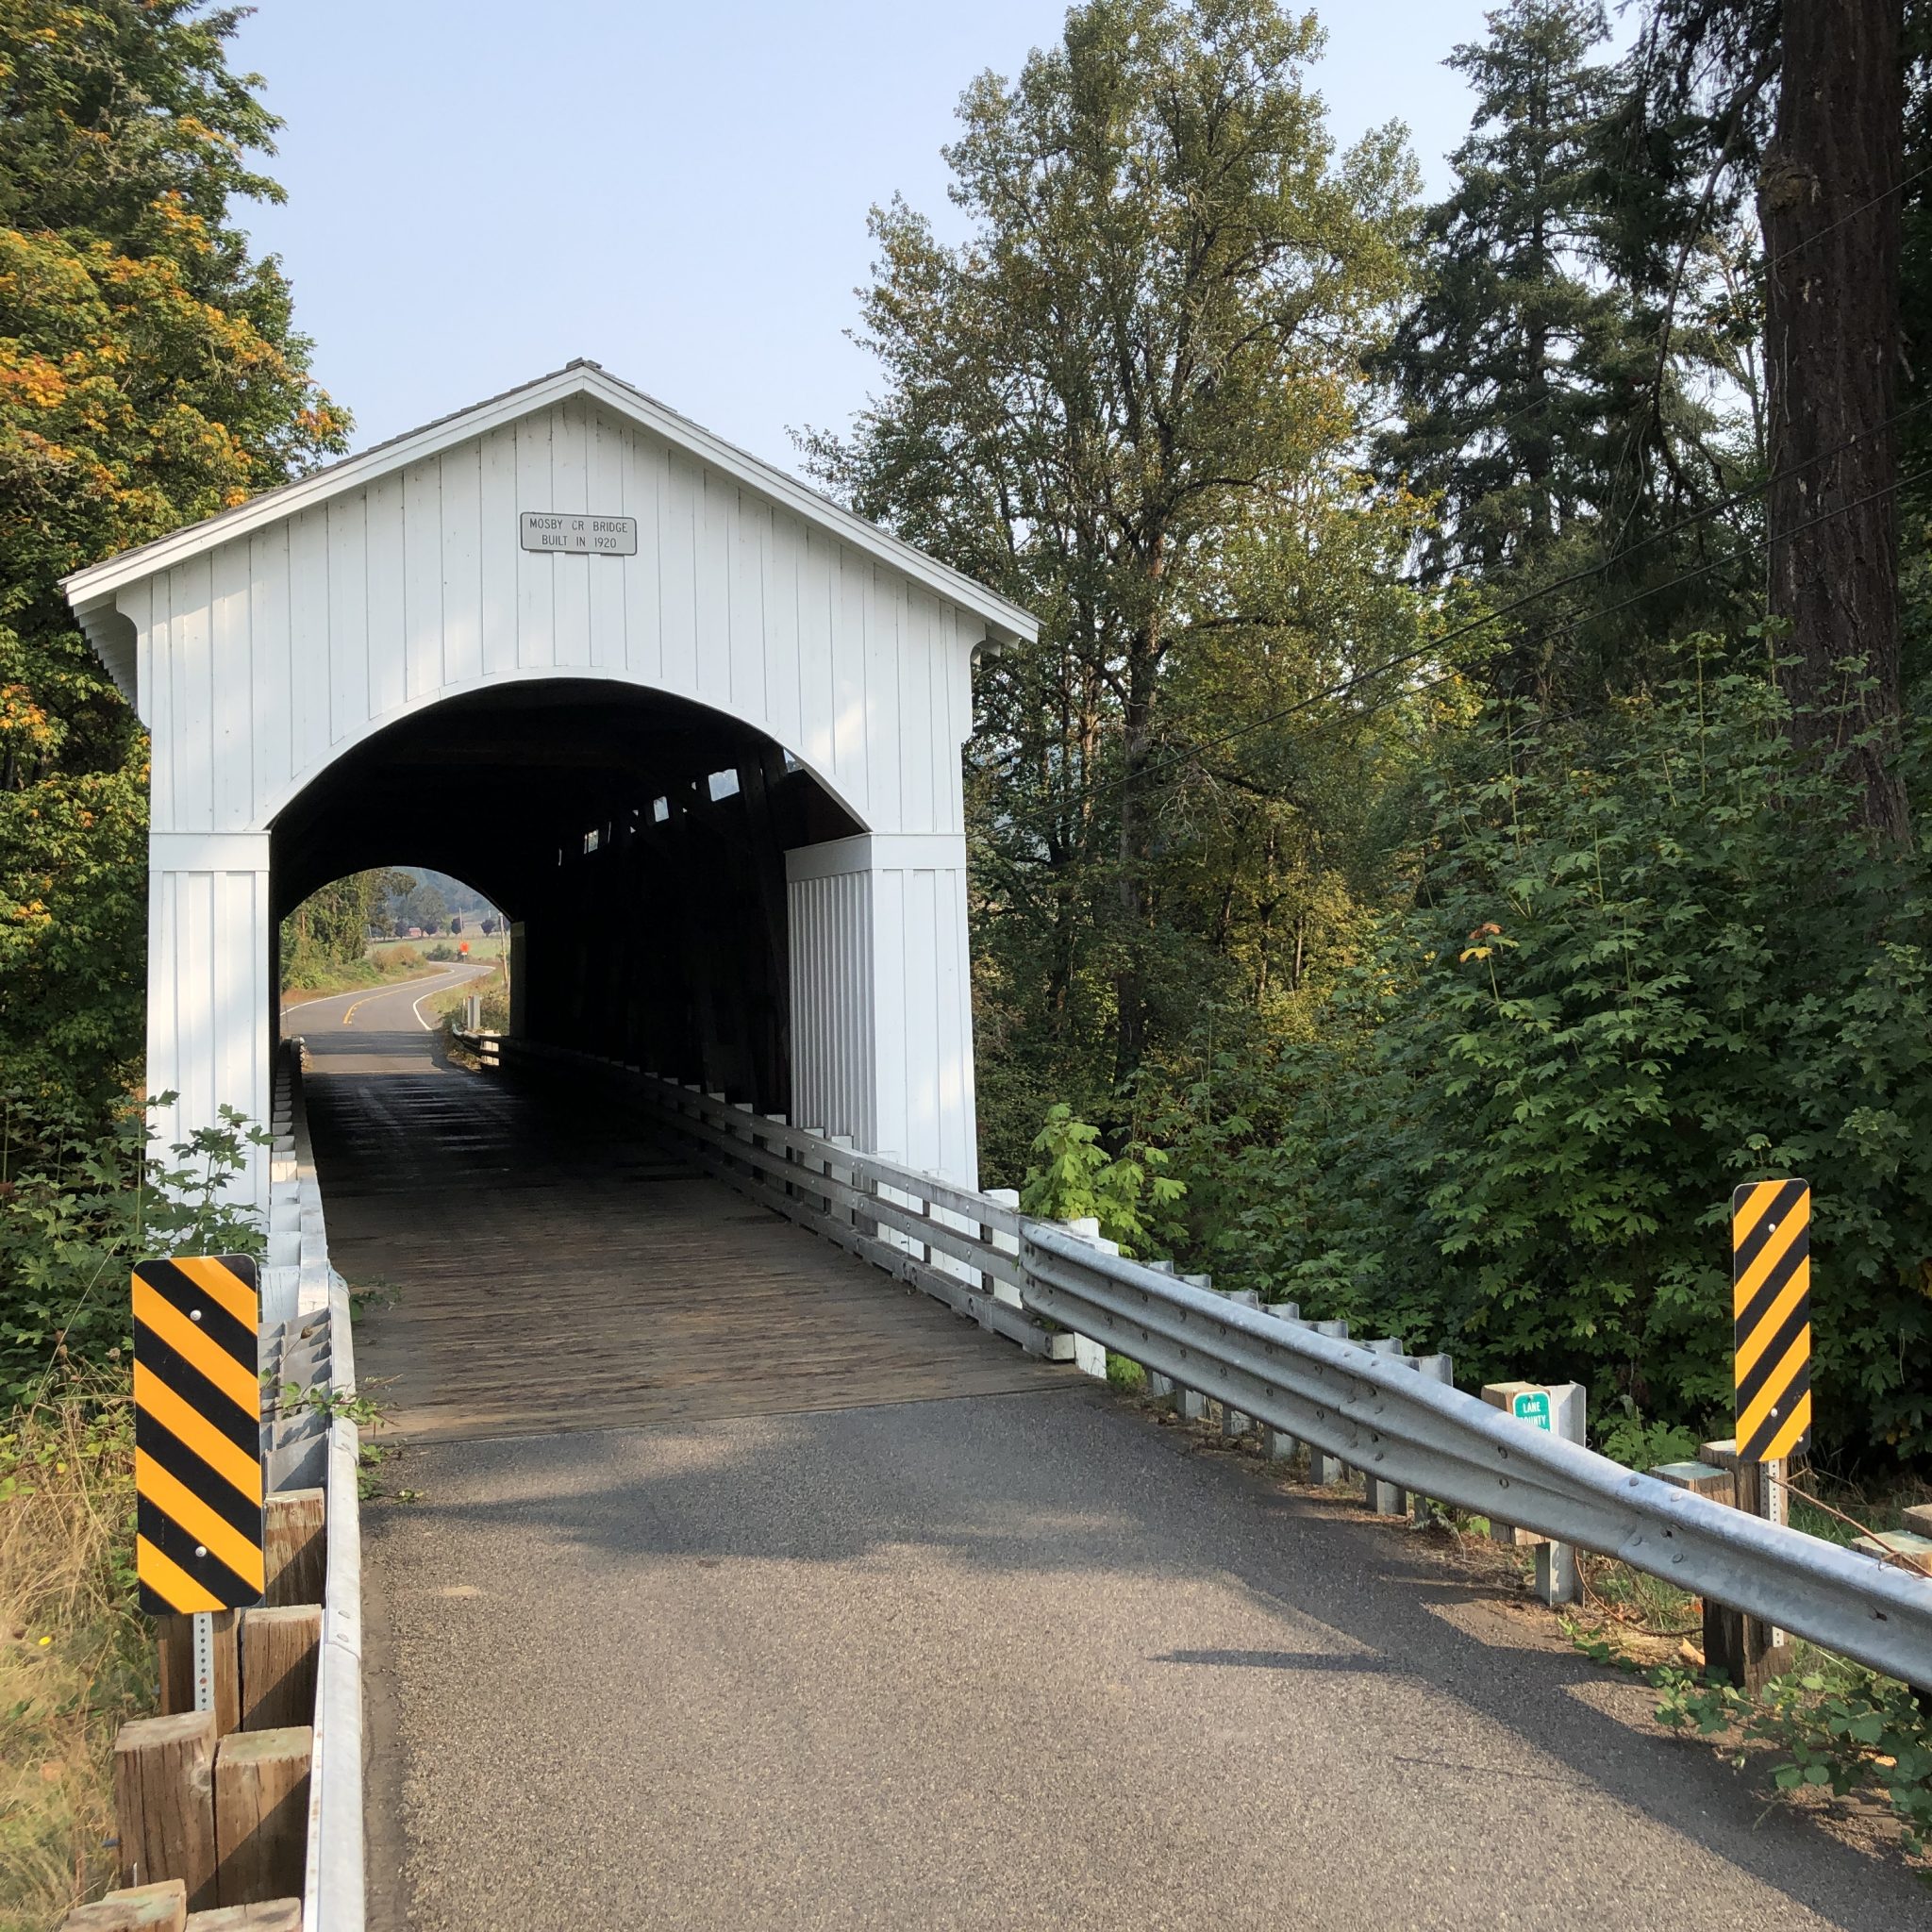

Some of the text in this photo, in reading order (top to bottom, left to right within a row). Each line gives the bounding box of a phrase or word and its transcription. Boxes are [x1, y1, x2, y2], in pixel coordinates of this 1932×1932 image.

[529, 518, 628, 533] MOSBY CR BRIDGE
[541, 535, 617, 548] BUILT IN 1920
[1523, 1401, 1541, 1413] LANE
[1520, 1414, 1546, 1426] OUNTY
